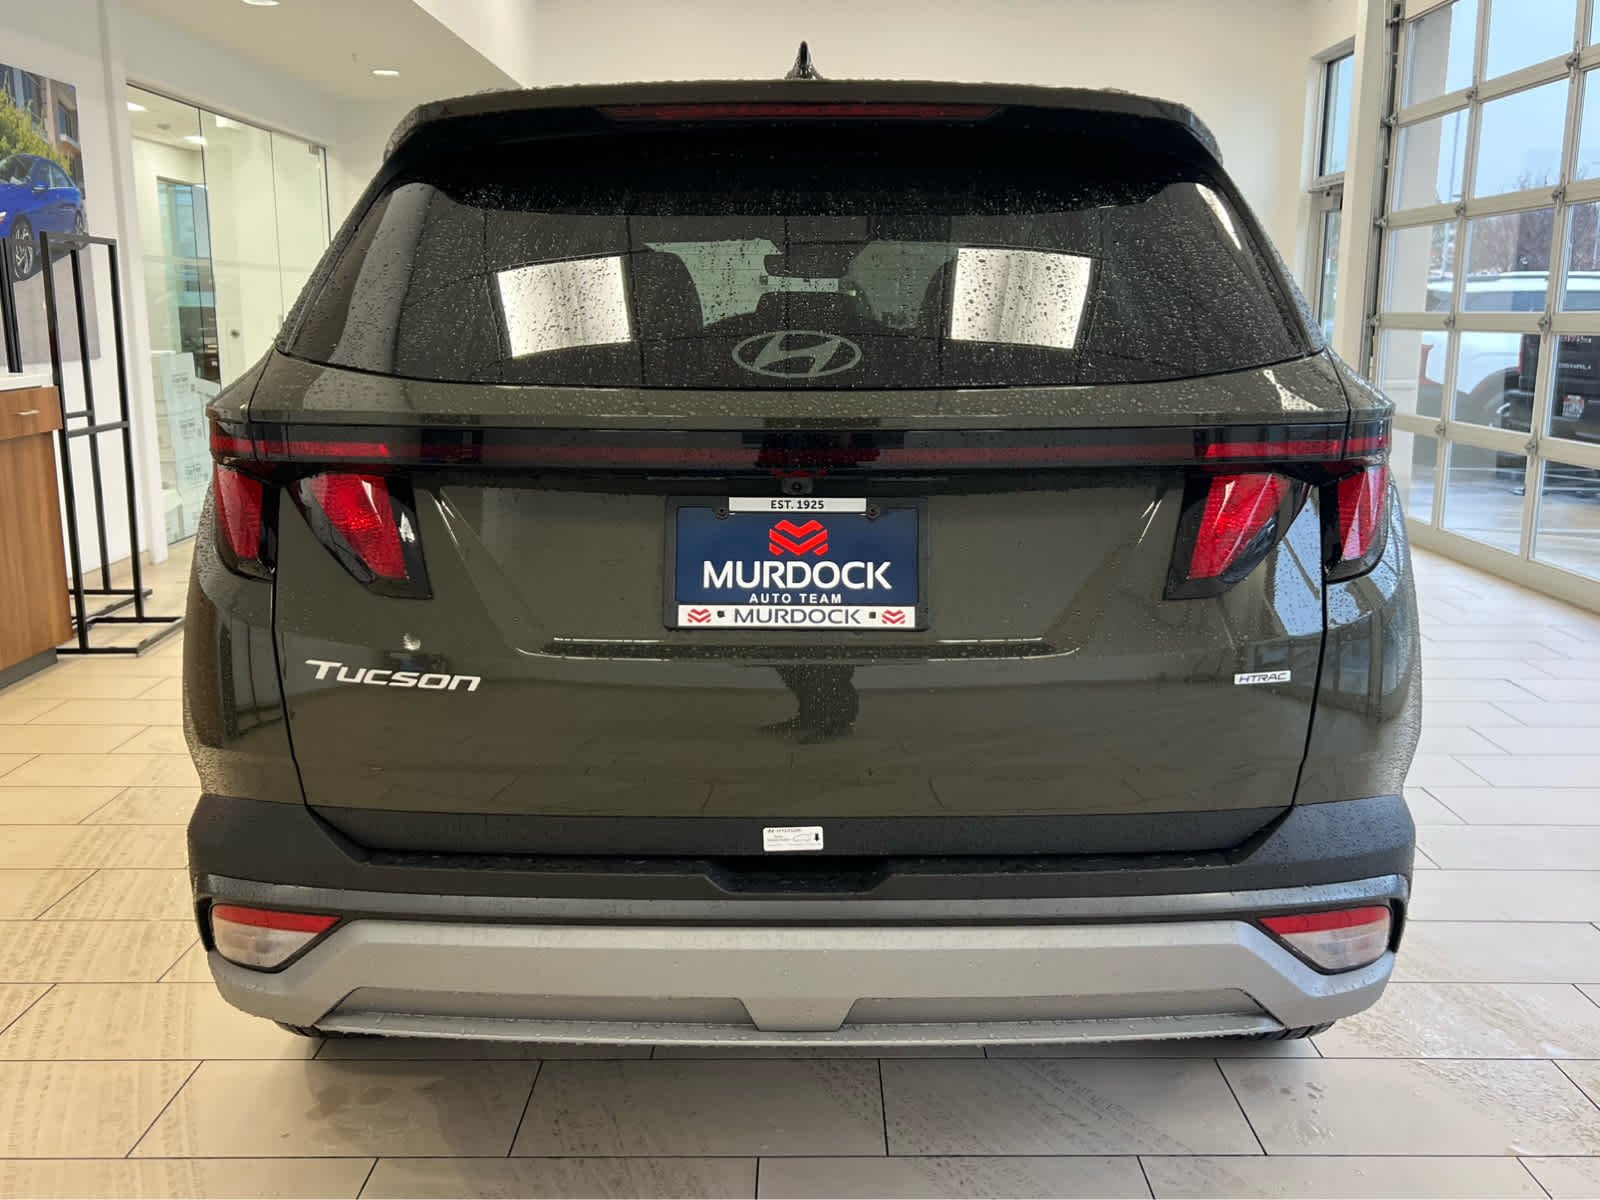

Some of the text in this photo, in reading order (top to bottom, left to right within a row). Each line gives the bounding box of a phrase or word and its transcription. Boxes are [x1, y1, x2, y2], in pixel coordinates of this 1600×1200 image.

[770, 500, 824, 510] EST. 1925
[703, 561, 892, 590] MURDOCK
[749, 593, 842, 604] AUTO TEAM
[734, 608, 862, 624] MURDOCK
[1239, 672, 1289, 683] HTRAC
